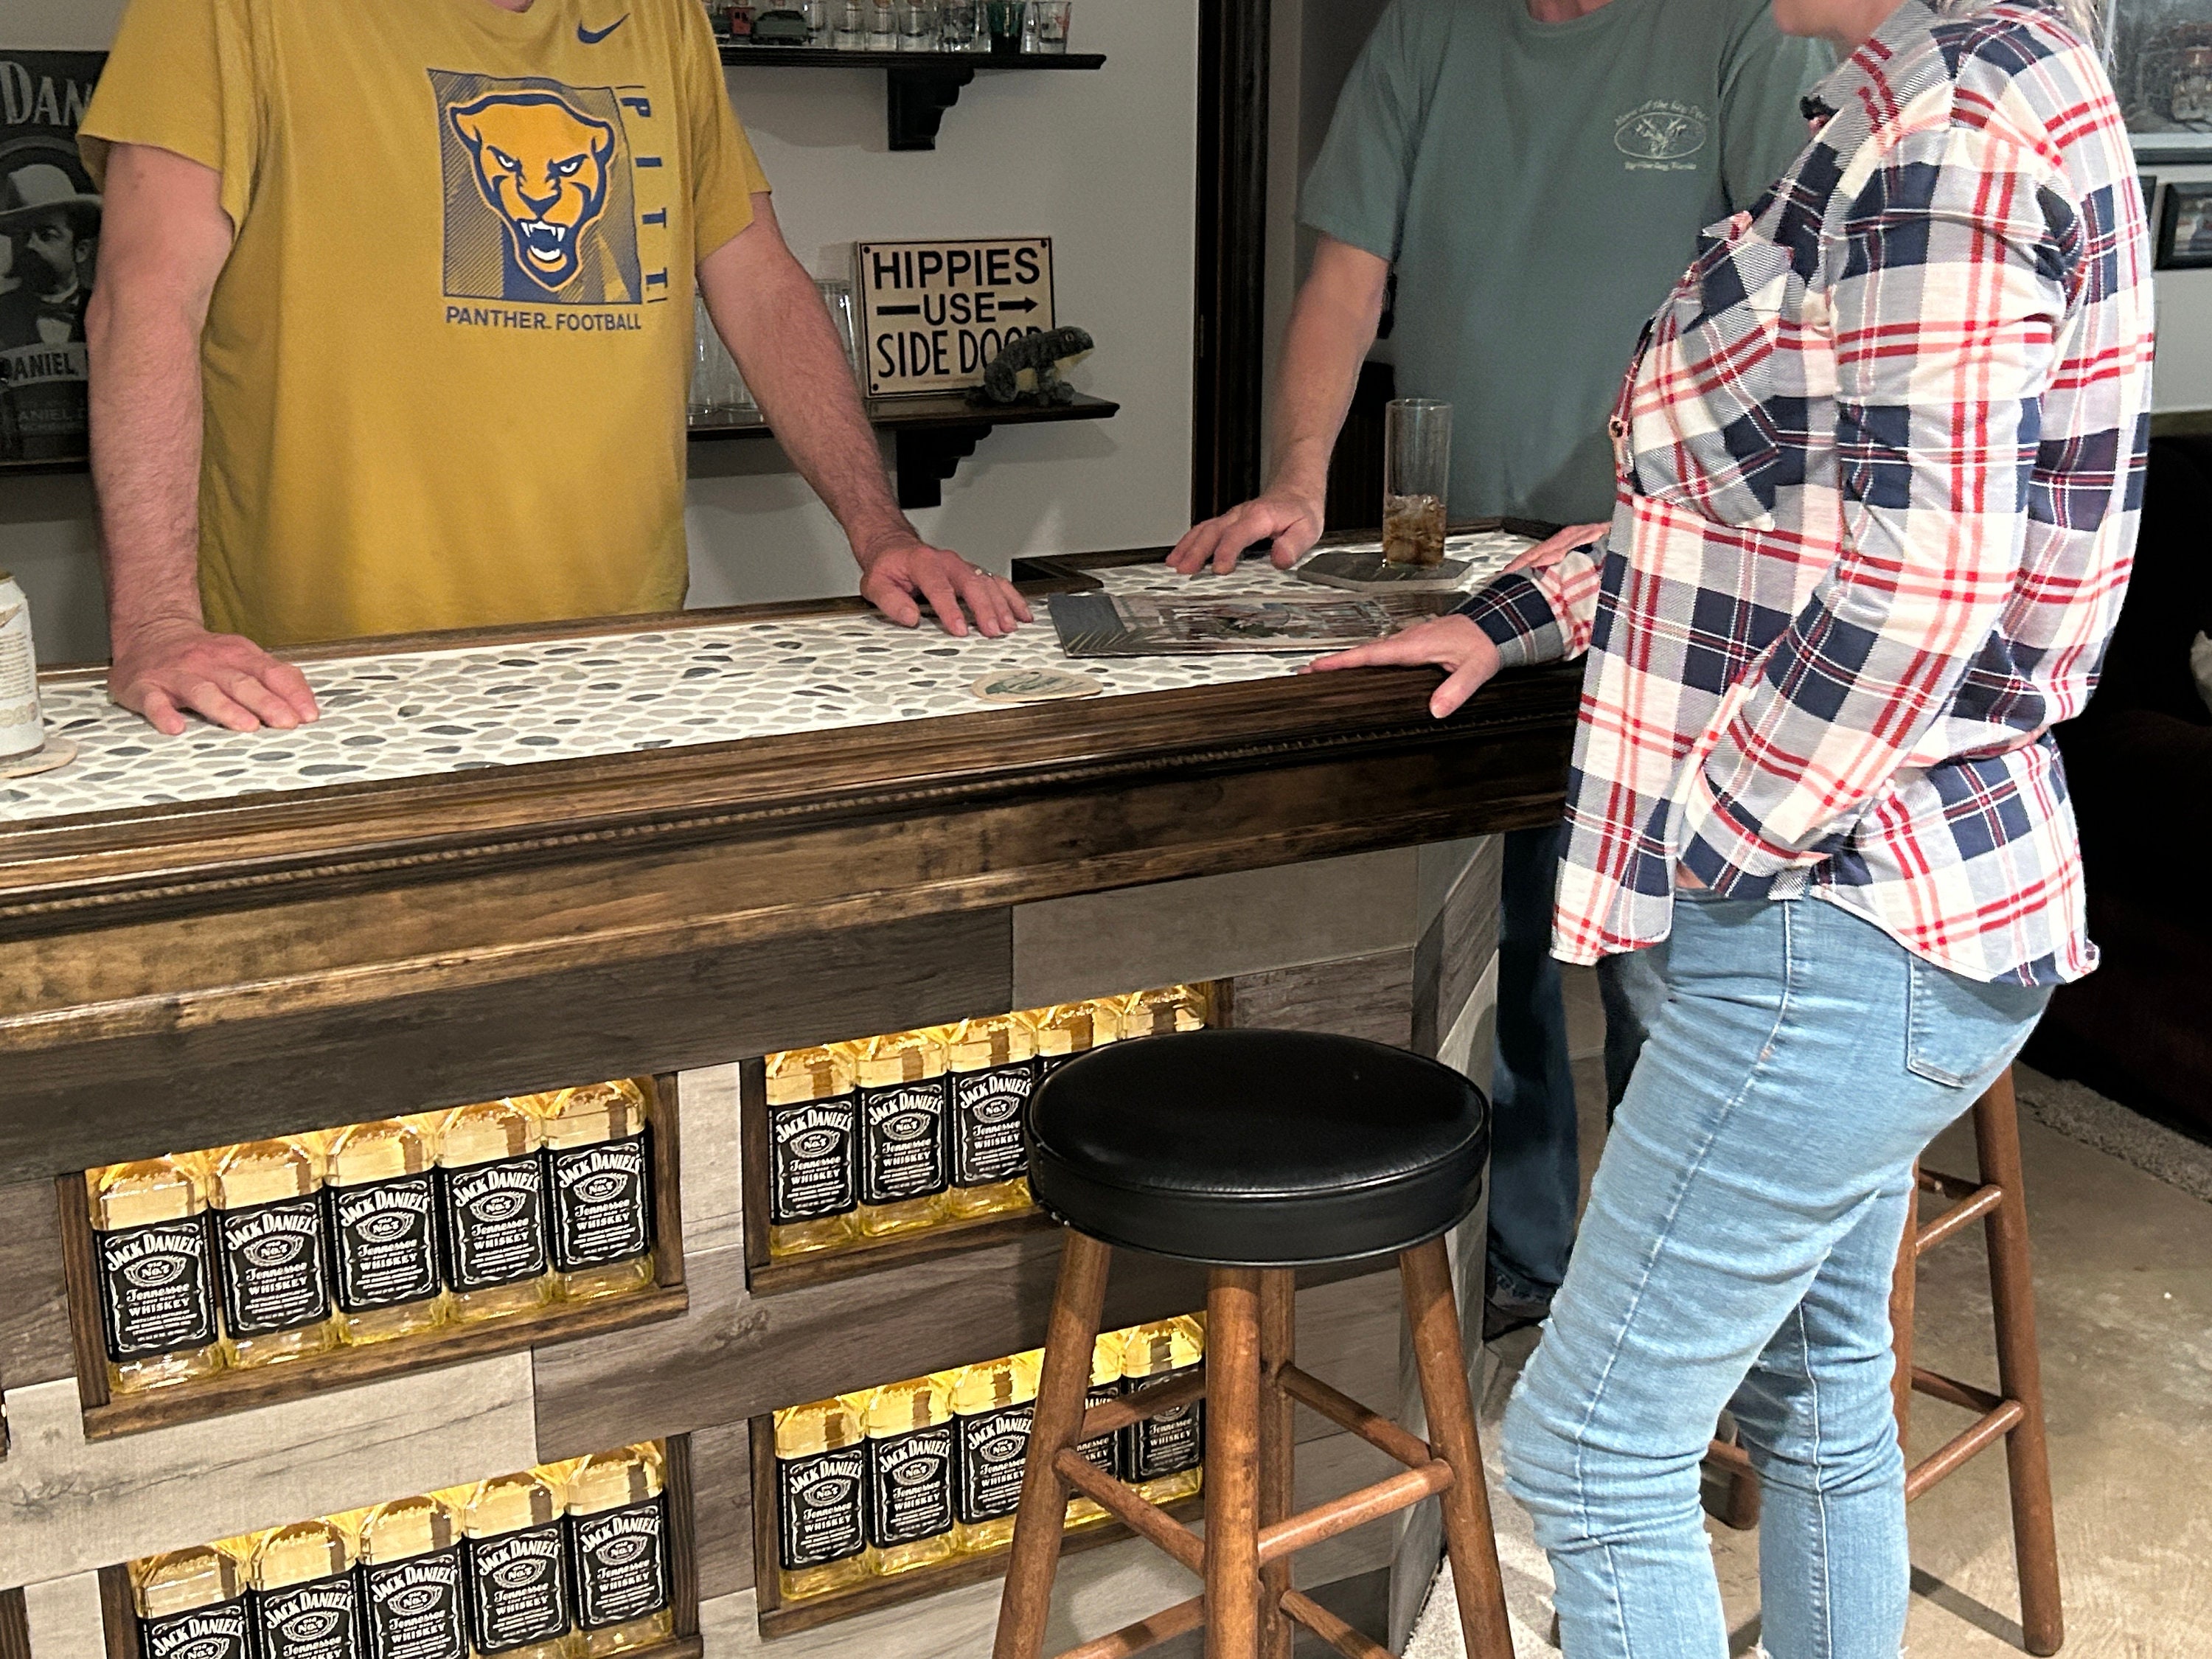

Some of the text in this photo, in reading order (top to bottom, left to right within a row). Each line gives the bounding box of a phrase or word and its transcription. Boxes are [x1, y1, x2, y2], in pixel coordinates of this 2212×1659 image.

[620, 97, 668, 288] PITT
[873, 248, 1040, 289] HIPPIES
[556, 313, 641, 331] FOOTBALL
[924, 292, 996, 325] USE
[877, 330, 950, 378] SIDE
[869, 1093, 945, 1125] JACK DANIEL'S
[960, 1077, 1033, 1109] JACK DANIEL'S
[776, 1110, 855, 1143] JACK DANIEL'S
[974, 1133, 1019, 1150] WHISKEY
[557, 1153, 642, 1189] JACK DANIEL'S
[883, 1152, 930, 1167] WHISKEY
[453, 1171, 541, 1207] JACK DANIEL'S
[791, 1169, 839, 1185] WHISKEY
[339, 1191, 431, 1227] JACK DANIEL'S
[577, 1213, 629, 1231] WHISKEY
[226, 1214, 320, 1251] JACK DANIEL'S
[473, 1232, 528, 1251] WHISKEY
[105, 1234, 204, 1271] JACK DANIEL'S
[360, 1253, 417, 1271] WHISKEY
[248, 1277, 307, 1296] WHISKEY
[129, 1298, 189, 1317] WHISKEY
[968, 1423, 995, 1450] JACK
[880, 1446, 908, 1473] JACK
[790, 1467, 819, 1494] JACK
[581, 1516, 661, 1553] JACK DANIEL'S
[478, 1539, 561, 1576] JACK DANIEL'S
[372, 1565, 458, 1603] JACK DANIEL'S
[599, 1573, 649, 1593] WHISKEY
[265, 1590, 355, 1629] JACK DANIEL'S
[495, 1596, 548, 1615] WHISKEY
[152, 1616, 244, 1657] JACK DANIEL'S
[392, 1623, 445, 1644] WHISKEY
